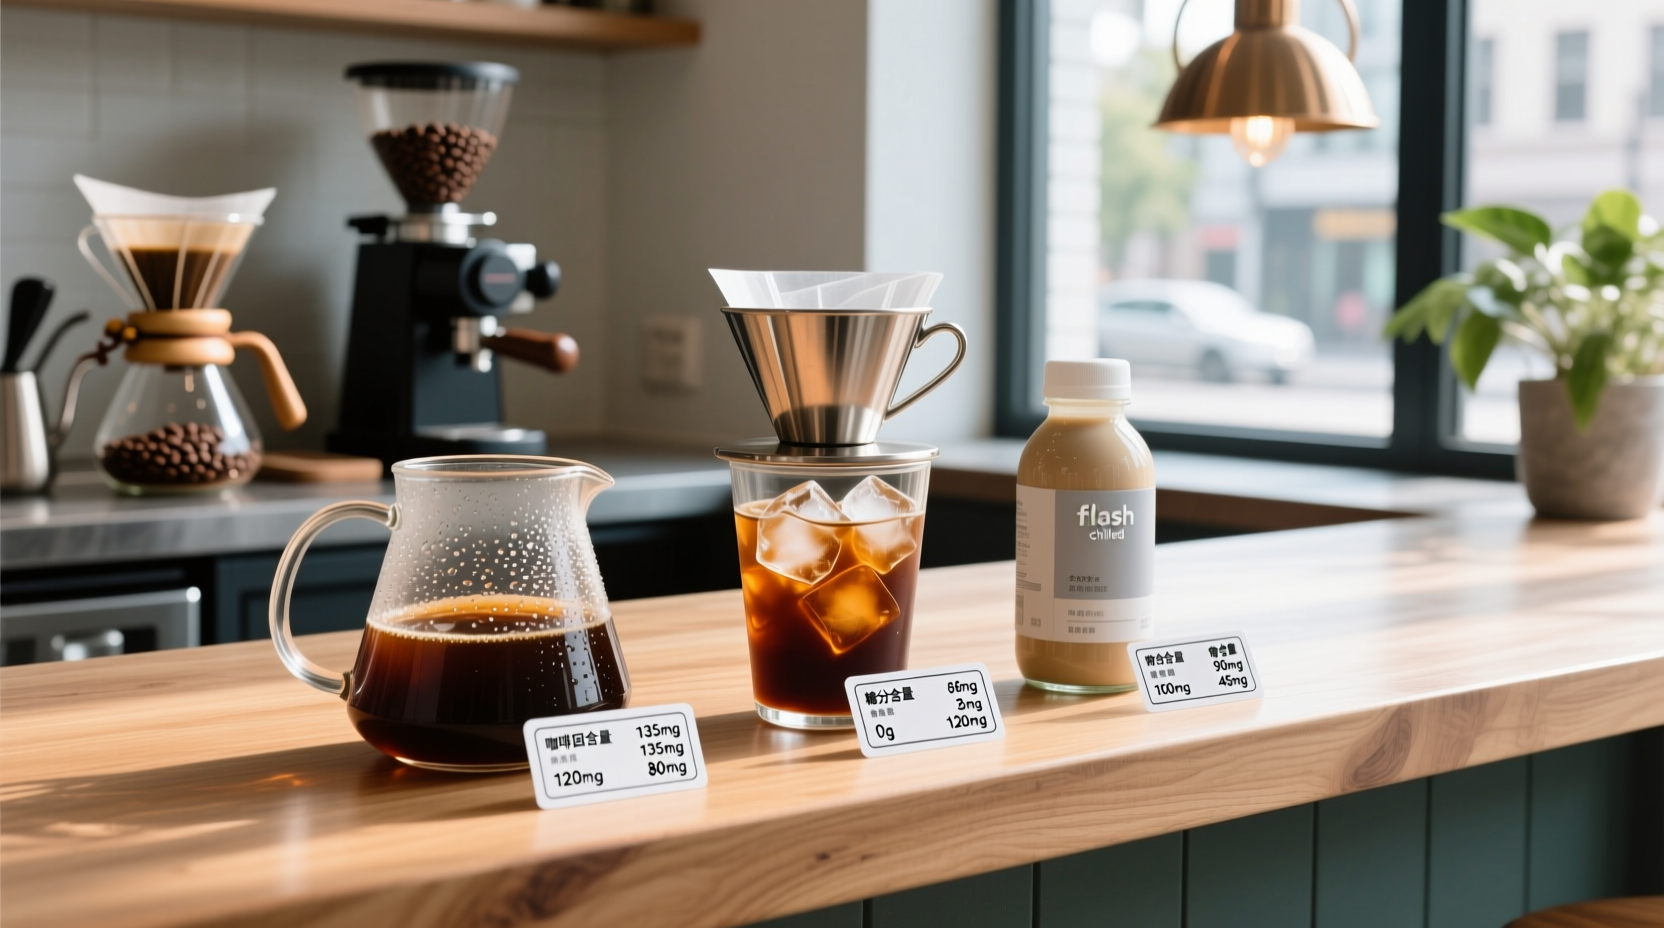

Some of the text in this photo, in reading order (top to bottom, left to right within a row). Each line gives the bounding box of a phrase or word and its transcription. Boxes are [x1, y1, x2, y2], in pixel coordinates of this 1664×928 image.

[1076, 503, 1135, 527] flash
[1213, 659, 1244, 672] 90mg
[1218, 675, 1248, 688] 45mg
[635, 723, 681, 738] 135mg
[875, 724, 895, 741] 0g
[640, 741, 684, 756] 135mg
[648, 760, 687, 776] 80mg
[554, 770, 604, 787] 120mg
